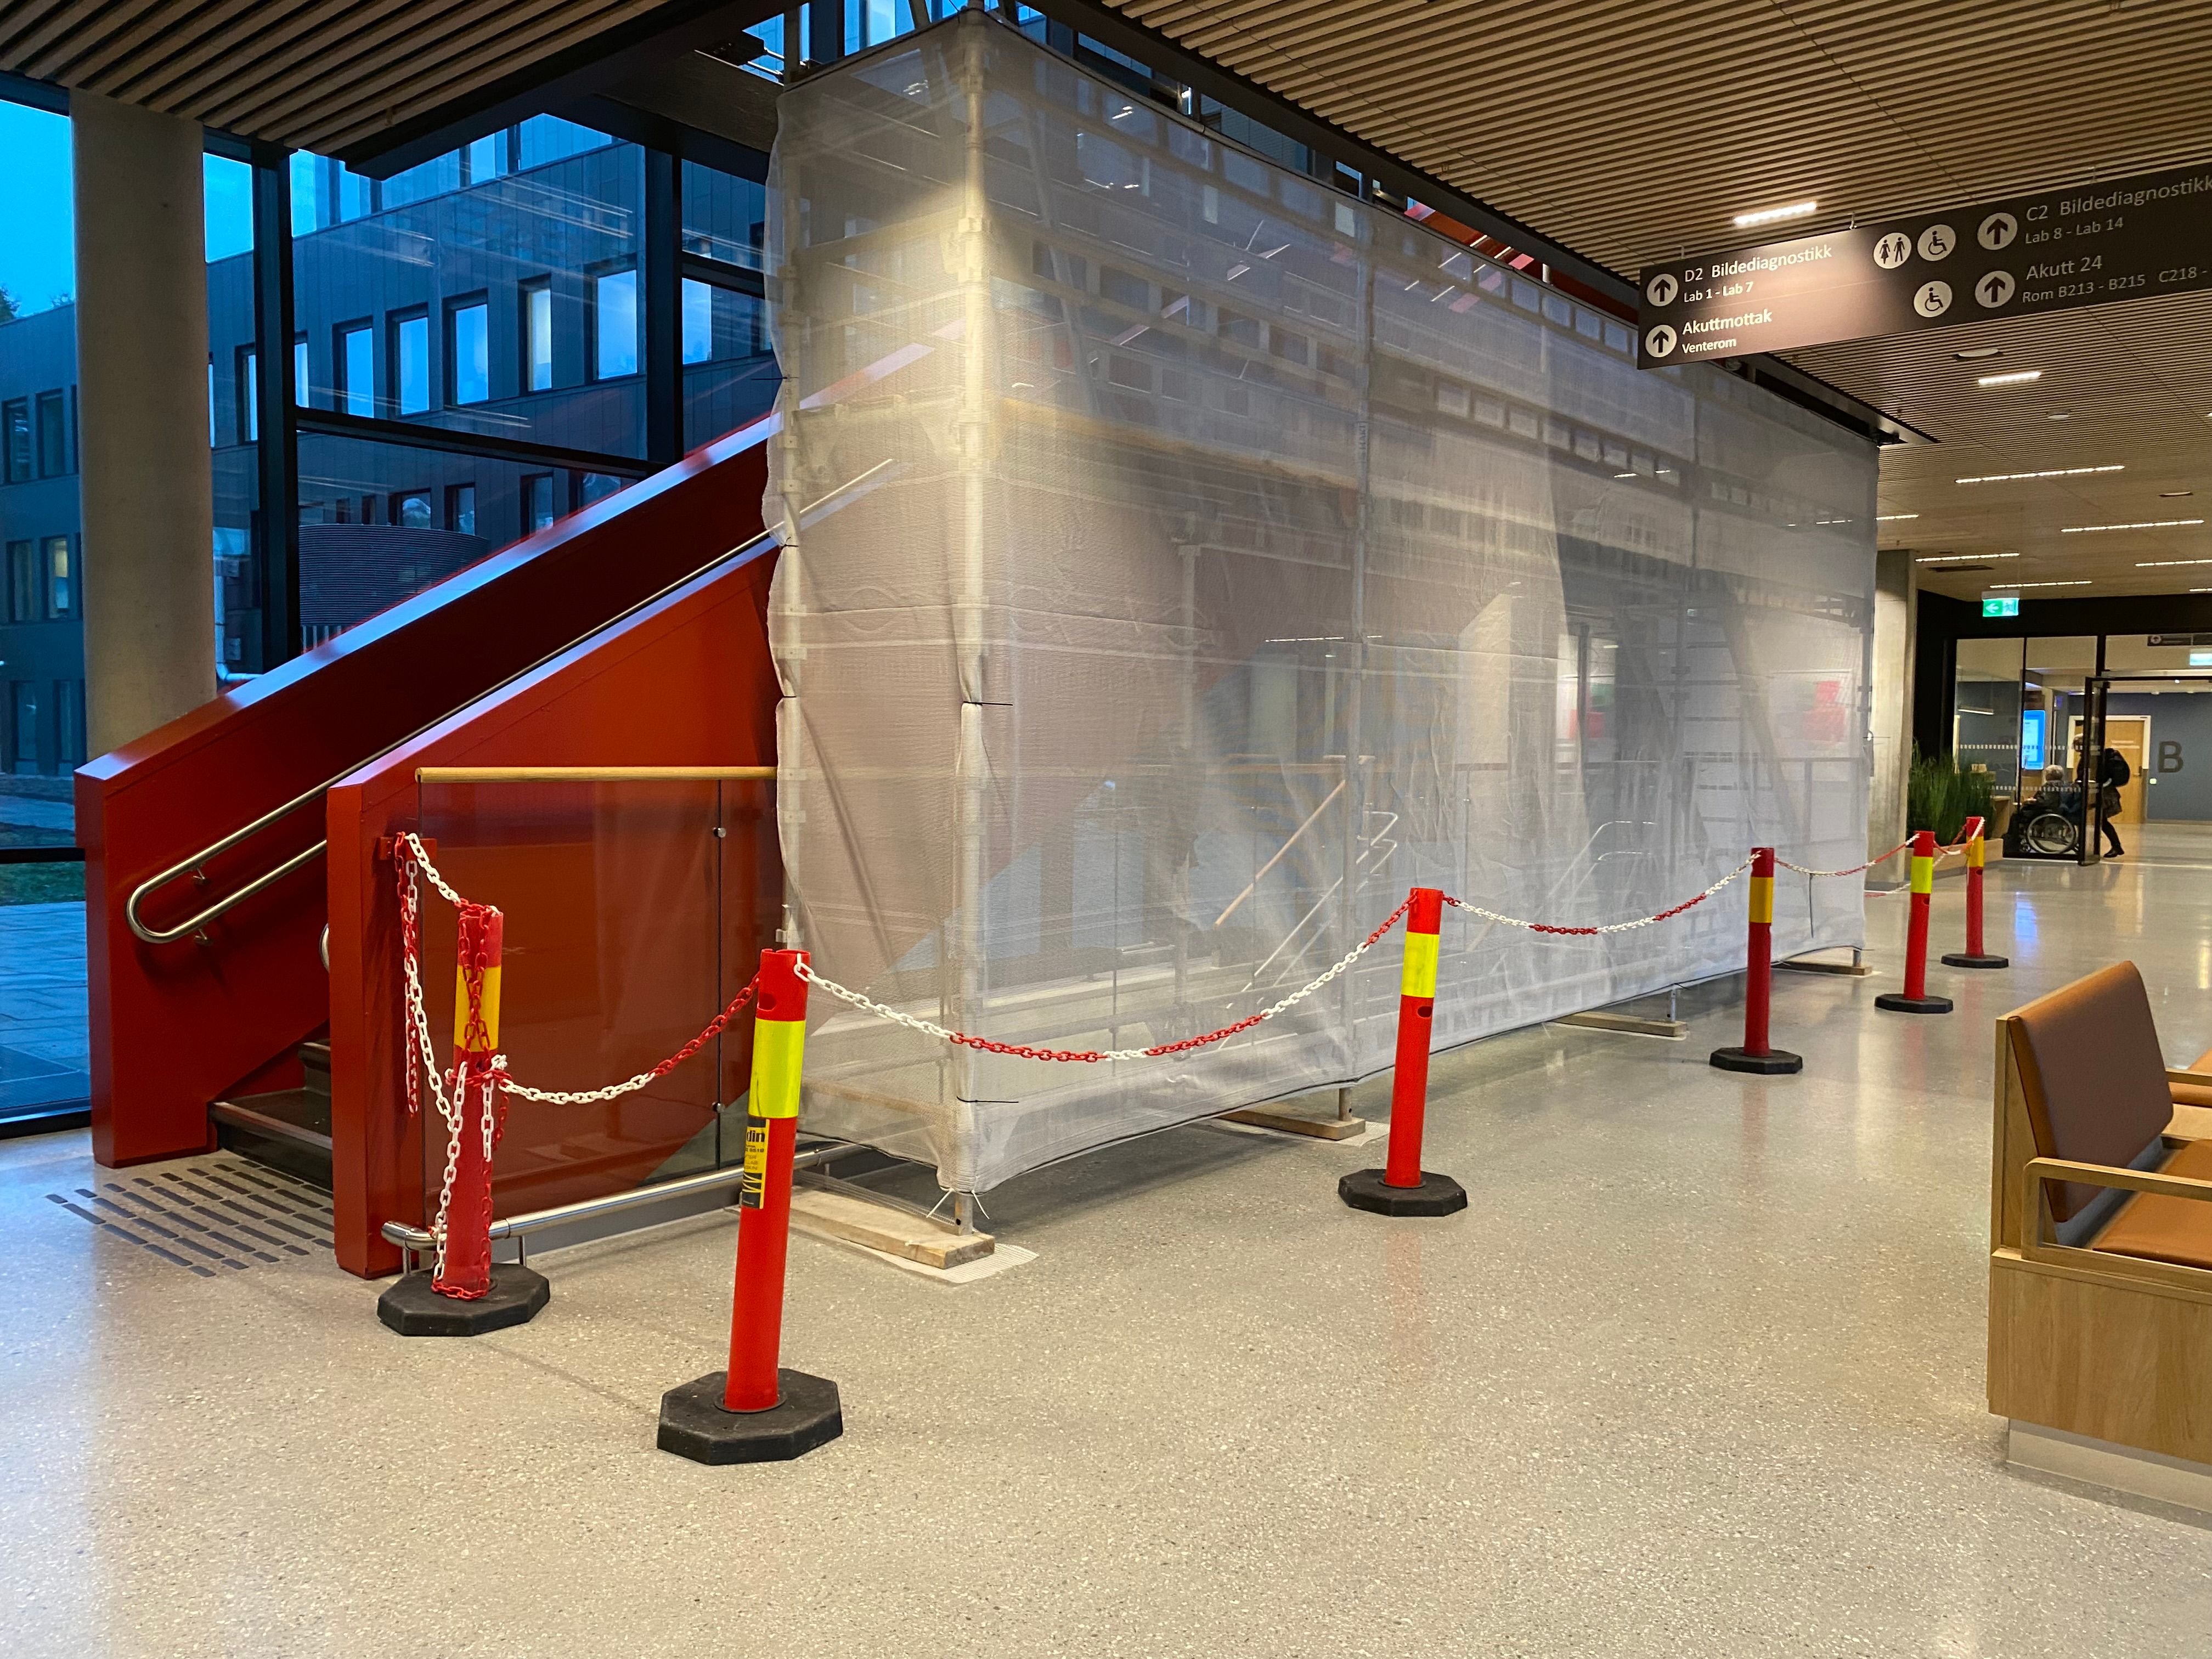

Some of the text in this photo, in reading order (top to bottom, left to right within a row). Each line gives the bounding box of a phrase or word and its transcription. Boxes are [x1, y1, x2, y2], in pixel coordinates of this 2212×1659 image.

[2026, 175, 2212, 221] C2 Bildediagnostikk
[2025, 230, 2049, 244] Lab
[2053, 227, 2062, 239] 8
[2076, 221, 2101, 235] Lab
[2107, 217, 2124, 231] 14
[1685, 245, 1832, 282] D2 Bildediagnostikk
[2025, 255, 2103, 280] Akutt 24
[1684, 290, 1703, 302] Lab
[1706, 288, 1712, 299] 1
[1723, 283, 1743, 296] Lab
[1746, 281, 1753, 292] 7
[2022, 290, 2054, 303] Rom
[2058, 281, 2094, 298] B213
[2109, 274, 2146, 291] B215
[2159, 267, 2197, 283] C218
[1682, 309, 1773, 335] Akuttmottak
[1682, 338, 1736, 353] Venterom
[2158, 741, 2183, 773] B
